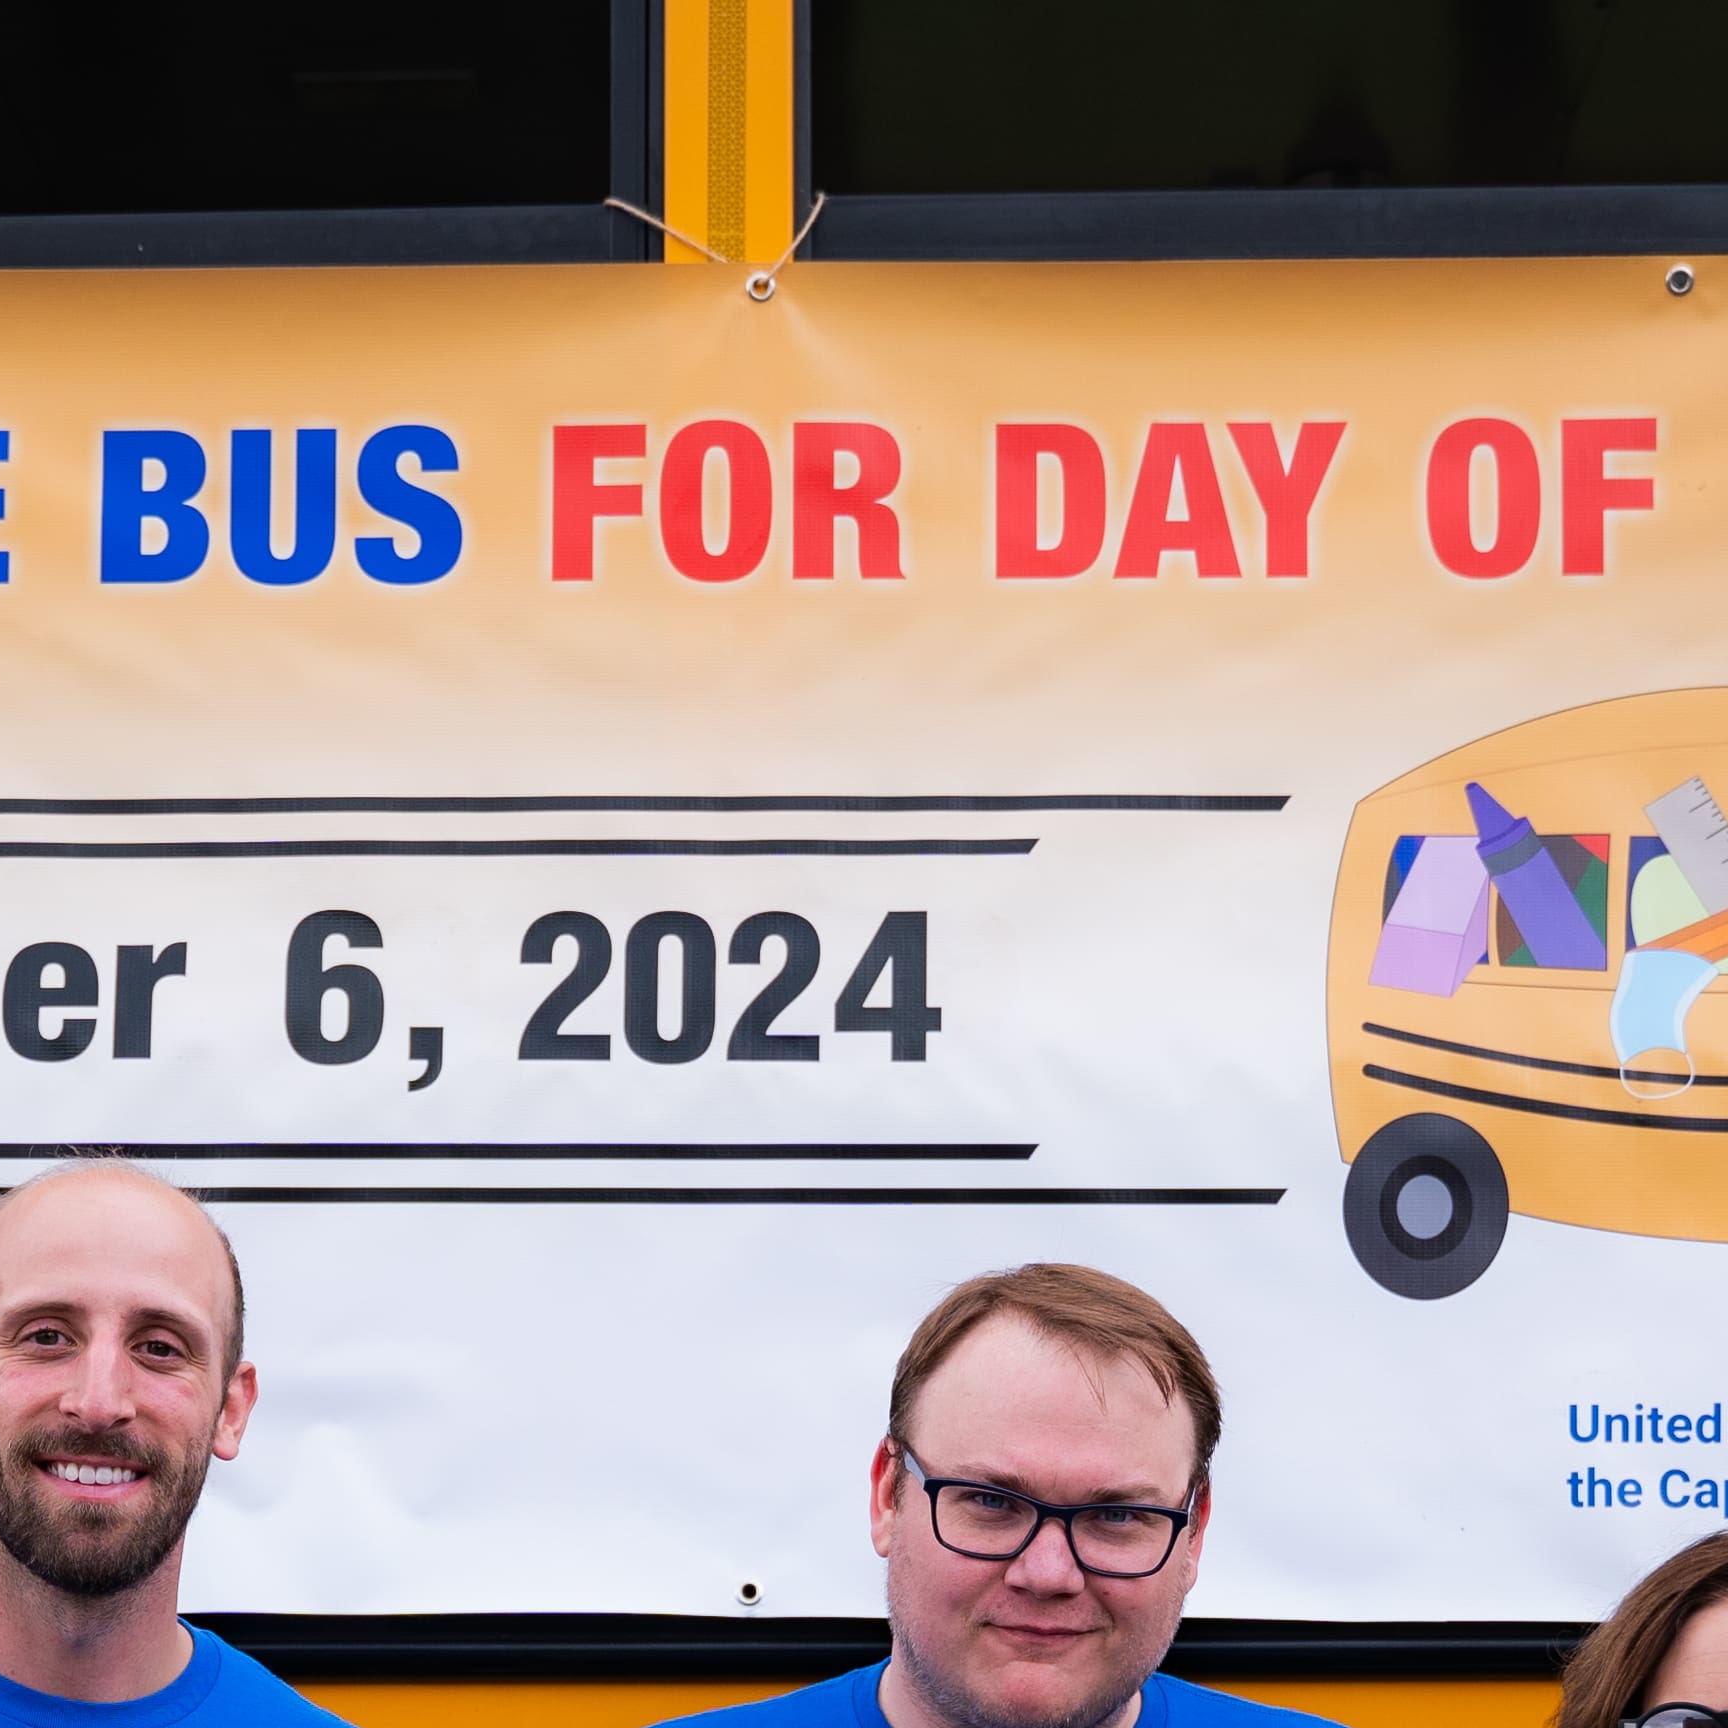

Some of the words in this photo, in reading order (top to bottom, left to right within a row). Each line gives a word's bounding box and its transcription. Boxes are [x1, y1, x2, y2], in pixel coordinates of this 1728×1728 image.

[100, 424, 463, 586] BUS
[551, 418, 905, 583] FOR
[995, 419, 1347, 579] DAY
[1426, 416, 1658, 580] OF
[285, 909, 444, 1092] 6,
[517, 910, 942, 1065] 2024
[1569, 1402, 1722, 1444] United
[1566, 1466, 1643, 1508] the
